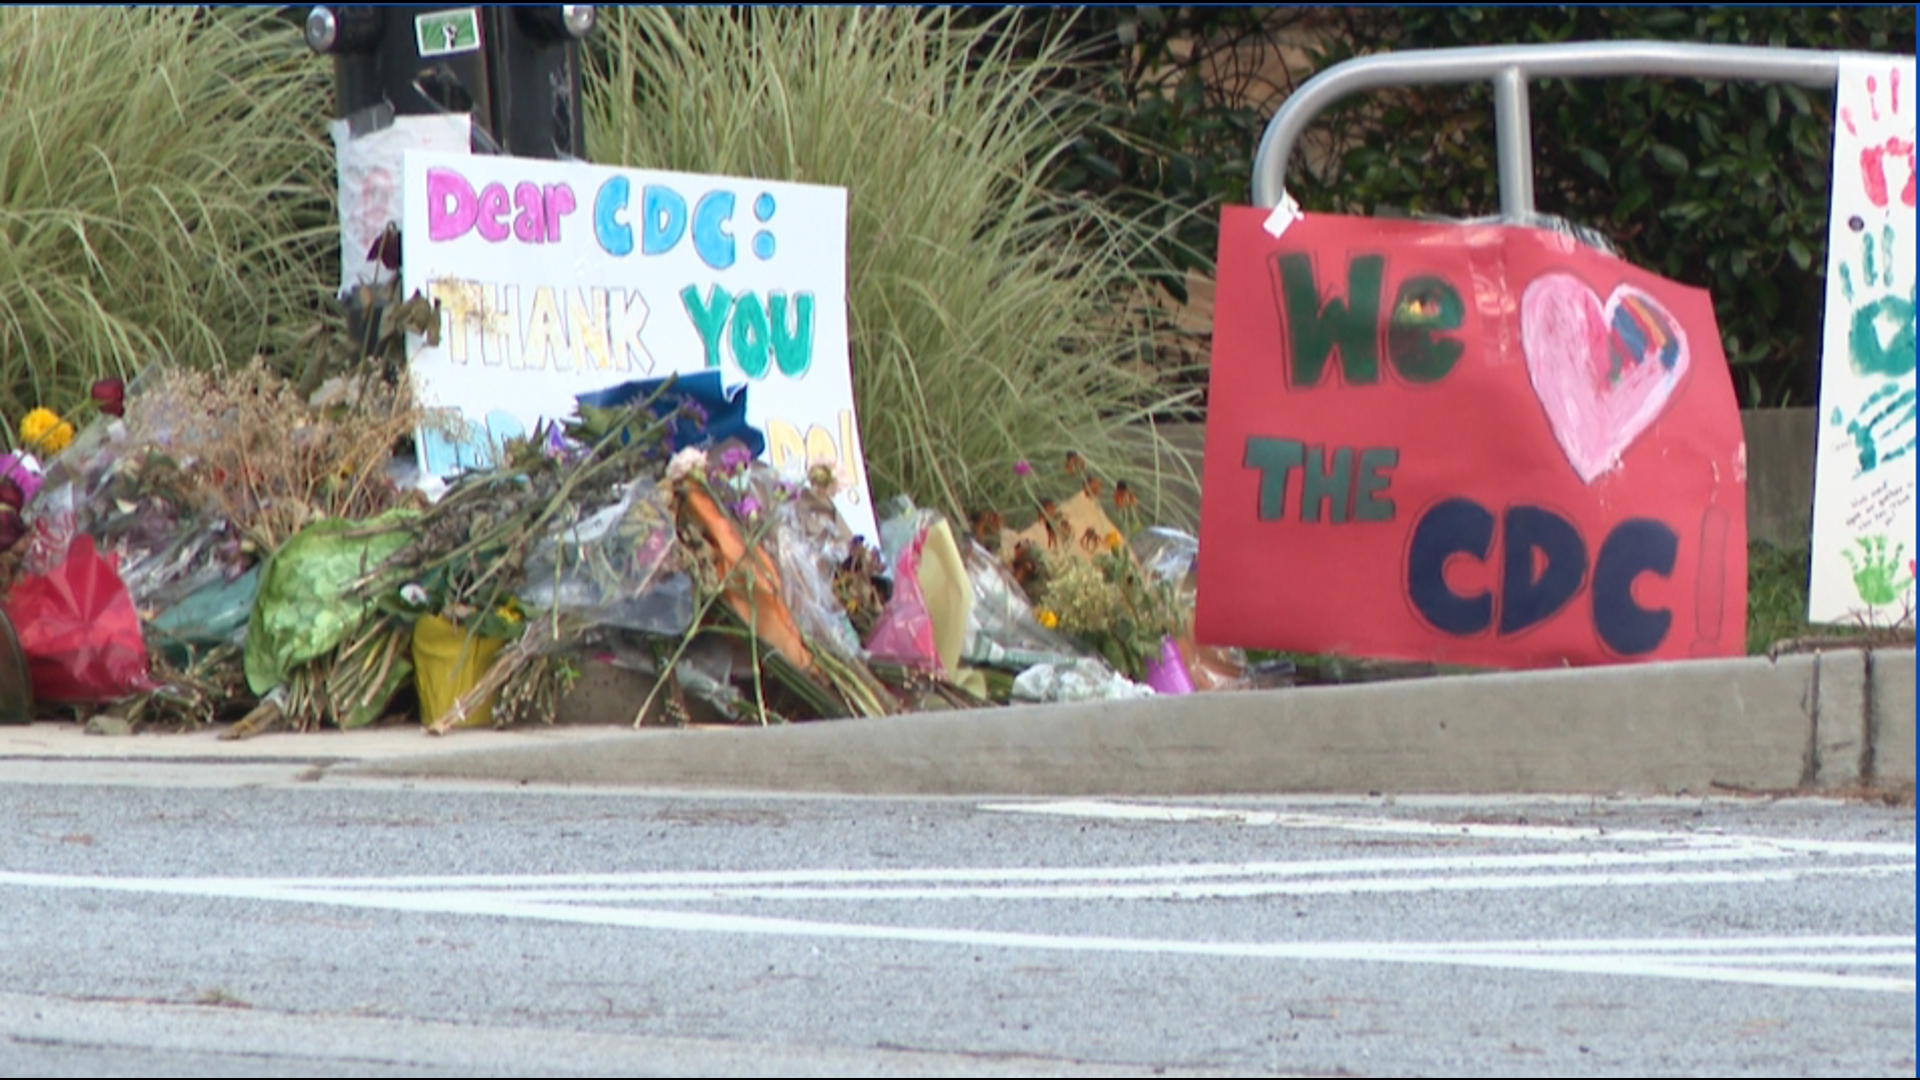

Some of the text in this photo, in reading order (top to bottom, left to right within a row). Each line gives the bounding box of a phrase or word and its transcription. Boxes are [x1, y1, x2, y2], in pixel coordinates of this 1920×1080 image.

[426, 167, 776, 270] Dear CDC:
[427, 279, 814, 379] THANK YOU
[1267, 249, 1466, 392] We
[1242, 435, 1400, 526] THE
